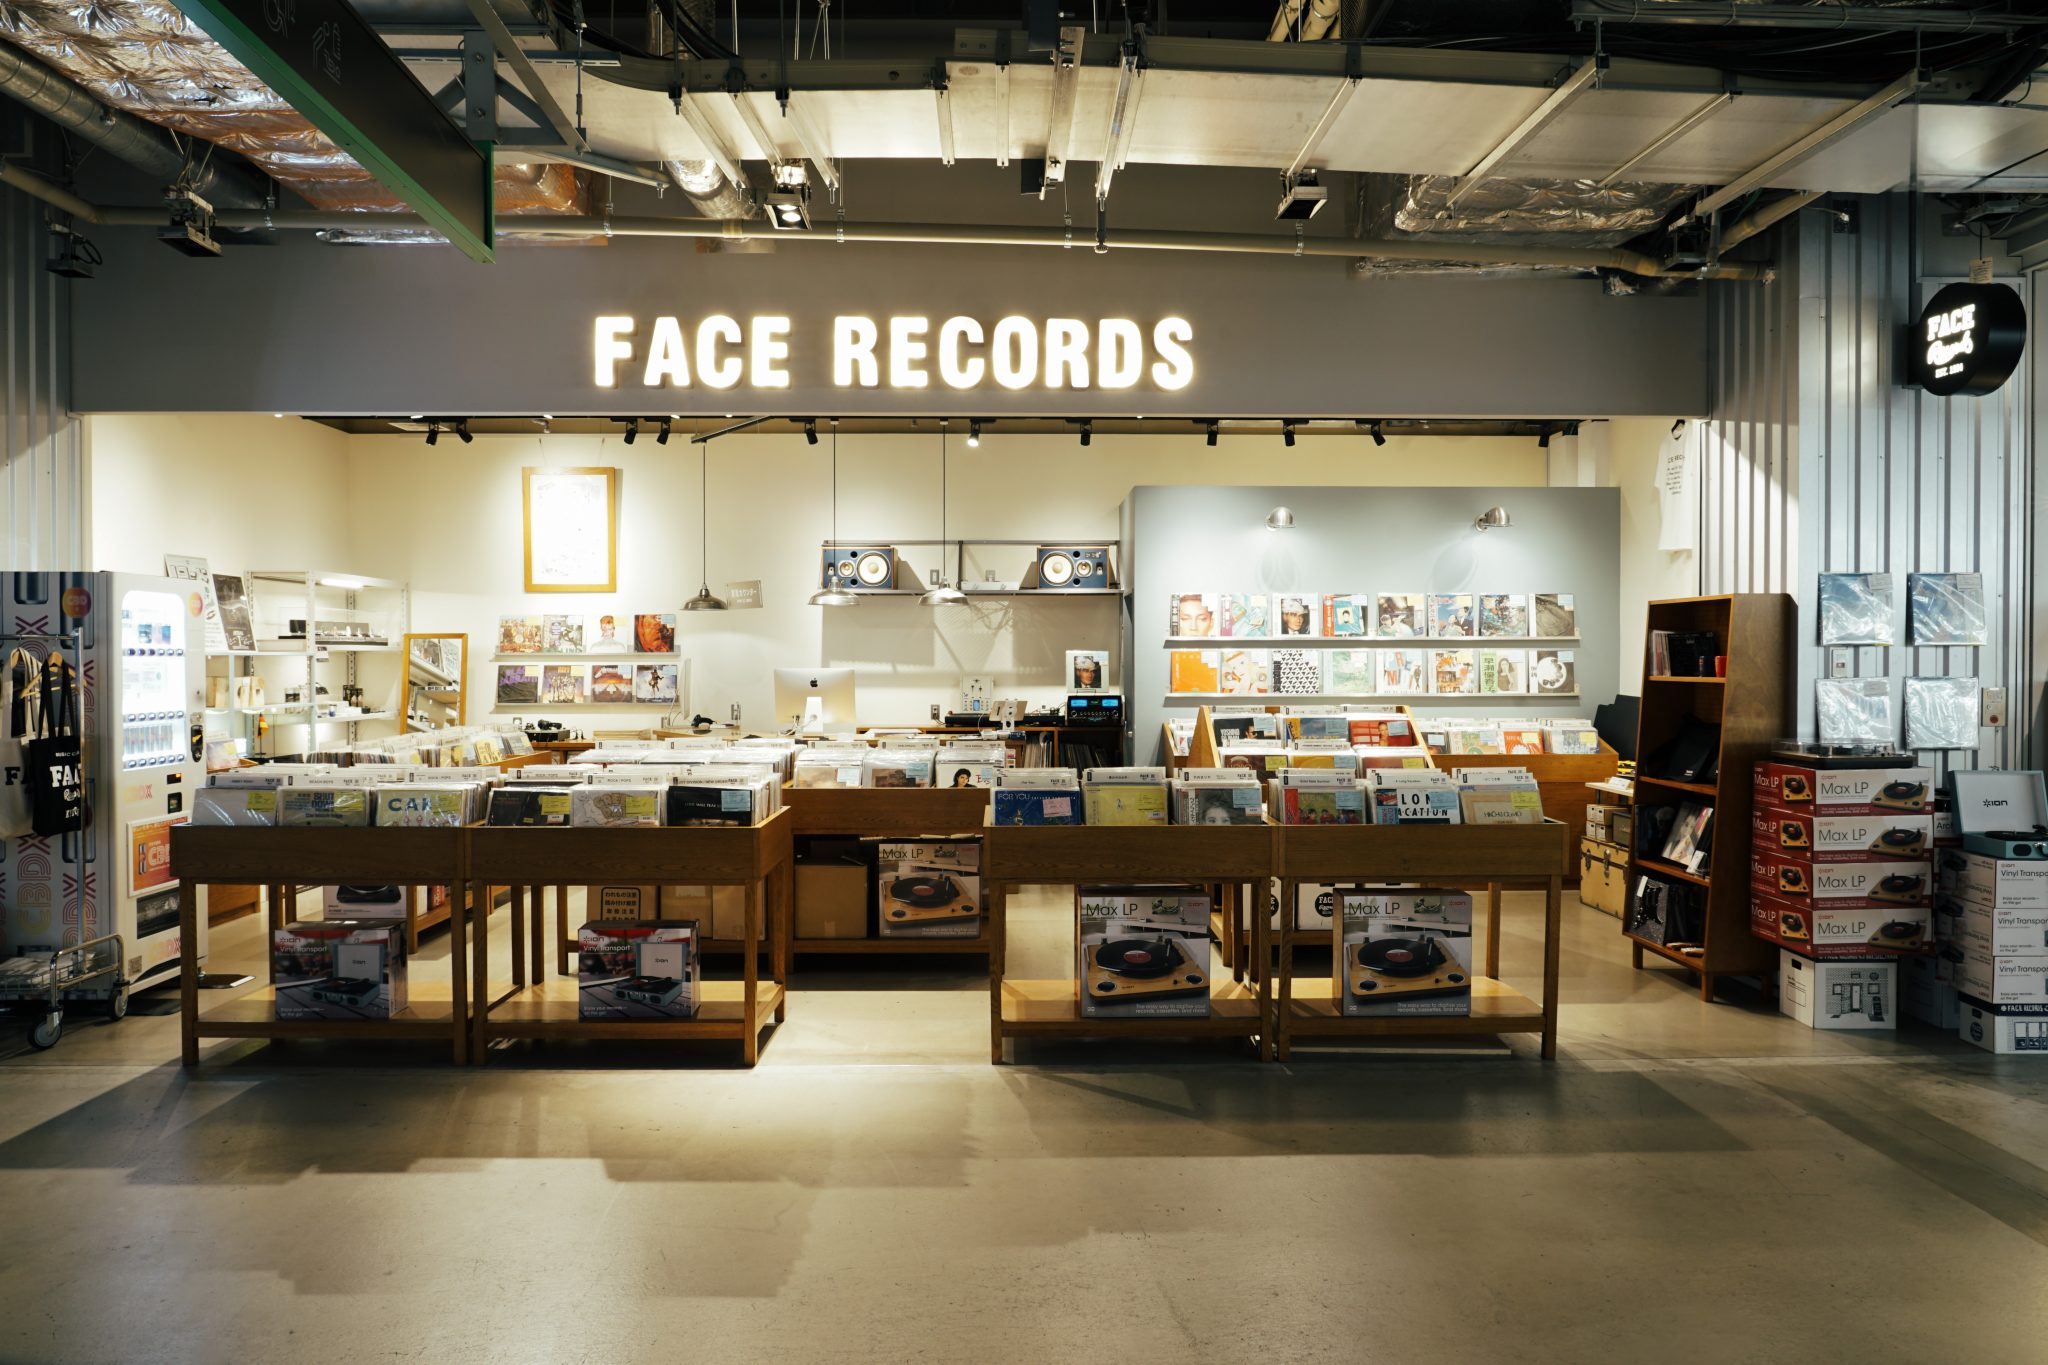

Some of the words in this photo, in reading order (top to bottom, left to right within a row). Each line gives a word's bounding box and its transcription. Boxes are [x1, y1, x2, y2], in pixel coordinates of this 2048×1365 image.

[1927, 303, 1976, 341] FACE
[594, 315, 792, 389] FACE
[833, 315, 1194, 390] RECORDS
[1821, 782, 1850, 795] Max
[1854, 781, 1869, 794] LP
[1818, 829, 1849, 841] Max
[1852, 828, 1867, 840] LP
[882, 848, 908, 859] Max
[911, 848, 924, 859] LP
[2001, 869, 2019, 877] Vinyl
[2020, 869, 2048, 878] Transpo
[1818, 876, 1847, 888] Max
[1851, 875, 1866, 887] LP
[1086, 903, 1118, 916] Max
[1122, 903, 1138, 916] LP
[1348, 902, 1380, 915] Max
[1384, 902, 1400, 915] LP
[1818, 922, 1847, 934] Max
[1851, 921, 1866, 933] LP
[1998, 917, 2015, 926] Vinyl
[2016, 917, 2048, 926] Transpor
[1999, 965, 2017, 974] Vinyl
[2017, 965, 2048, 974] Transpo
